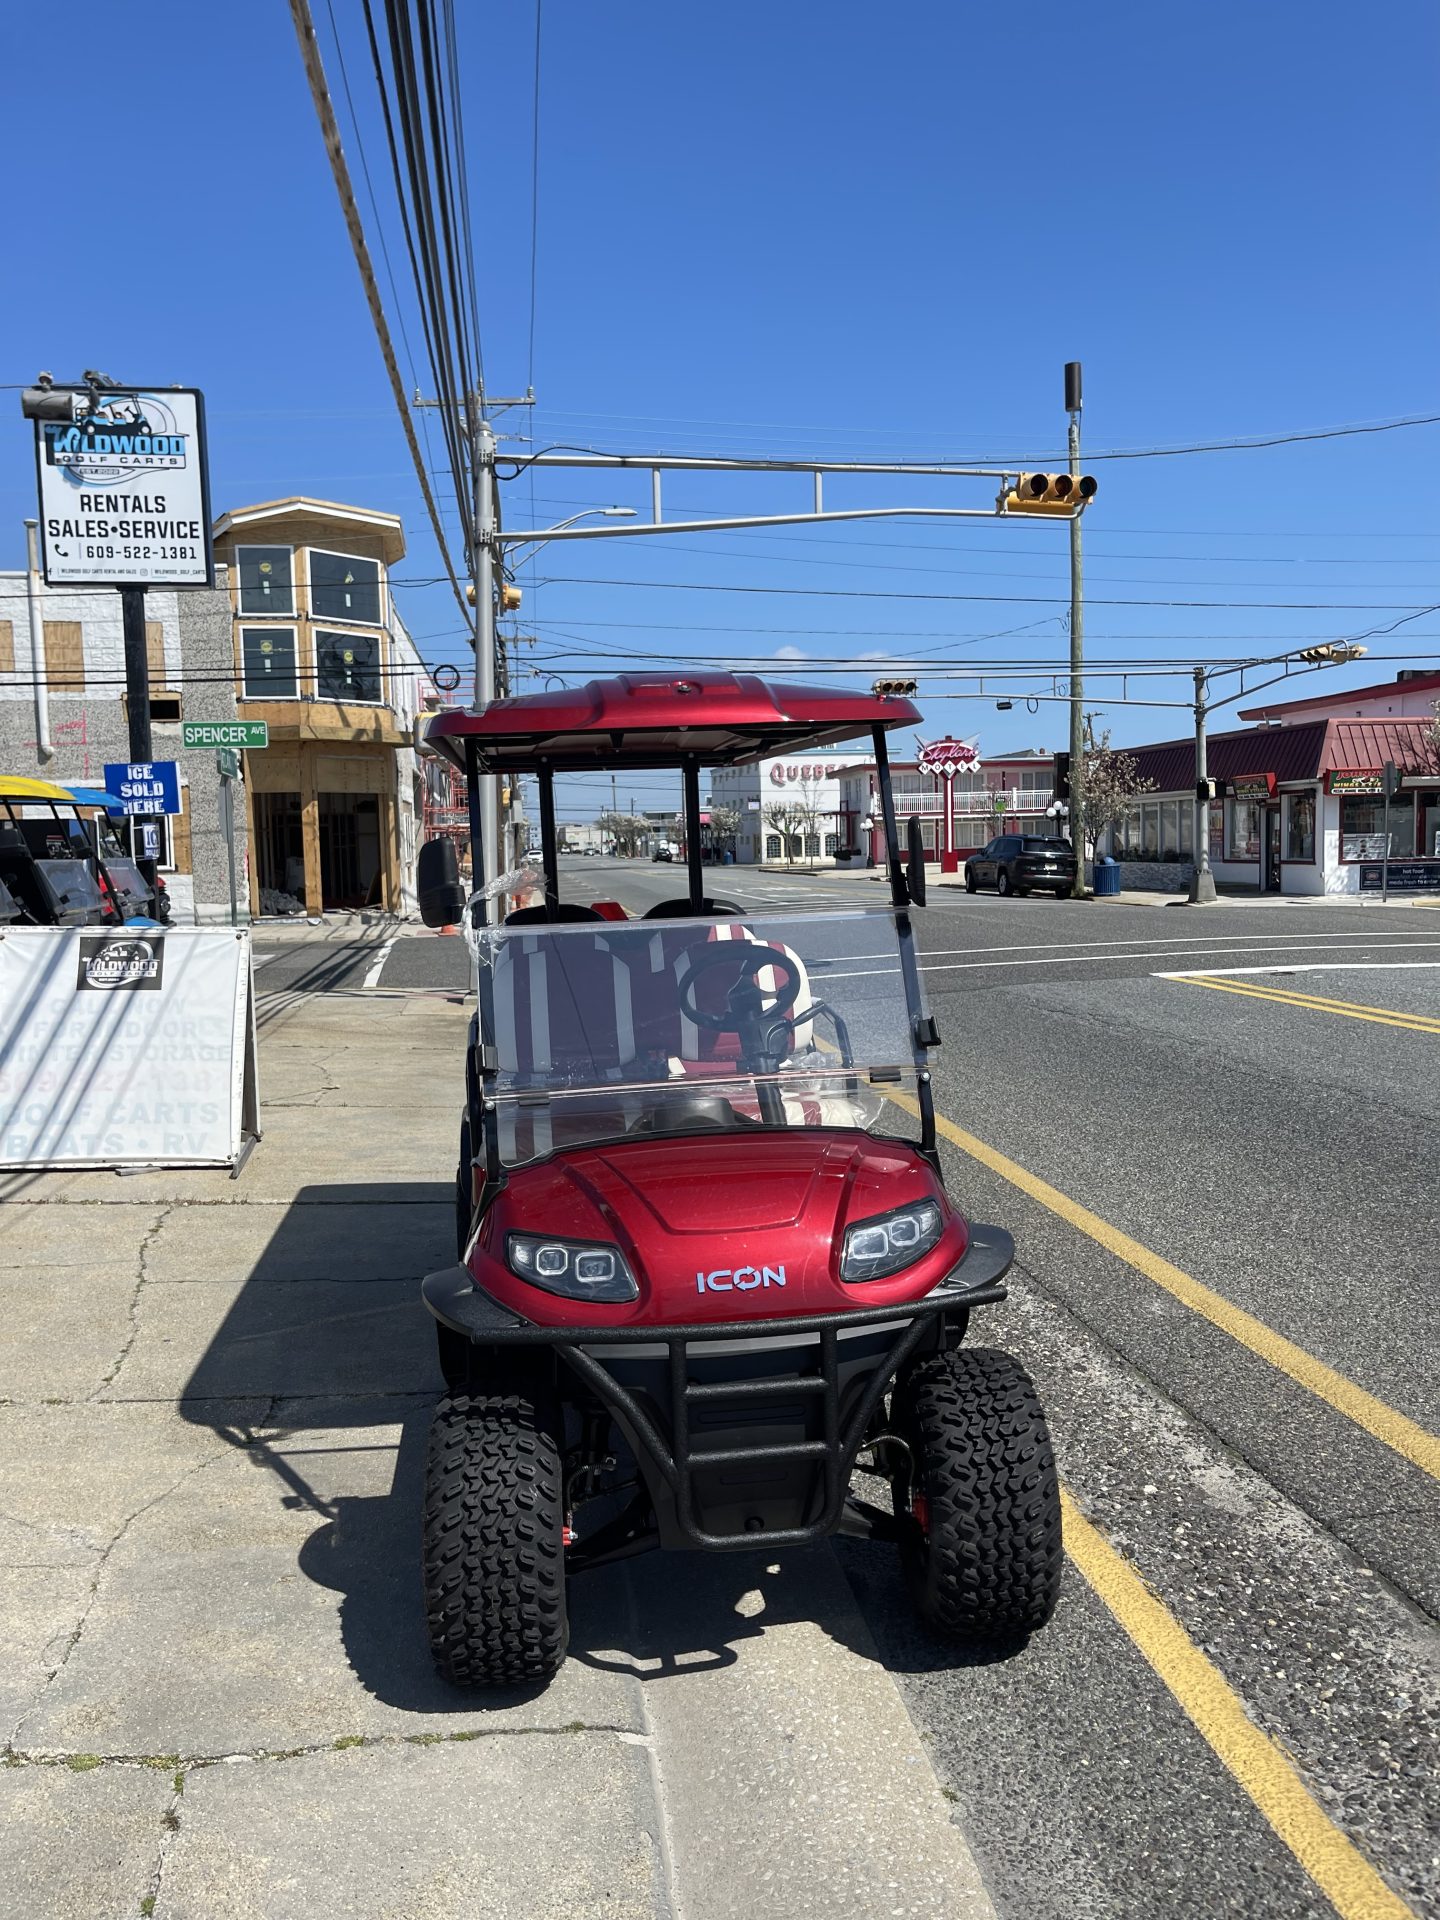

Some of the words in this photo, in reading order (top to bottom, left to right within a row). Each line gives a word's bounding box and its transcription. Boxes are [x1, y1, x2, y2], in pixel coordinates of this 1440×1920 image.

[46, 427, 185, 455] WILDWOOD
[63, 455, 108, 463] GOLF
[120, 456, 178, 465] CARTS
[80, 494, 166, 513] RENTALS
[87, 545, 197, 560] 609-522-1381
[185, 727, 247, 743] SPENCER
[251, 726, 265, 735] AVE
[923, 745, 977, 763] Skylark
[127, 764, 154, 780] ICE
[121, 783, 164, 797] SOLD
[123, 799, 165, 814] HERE
[82, 957, 158, 971] WILDWOOD
[105, 1101, 219, 1125] CARTS
[7, 1132, 125, 1157] BOATS
[163, 1132, 208, 1155] RV
[696, 1265, 787, 1294] ICON
